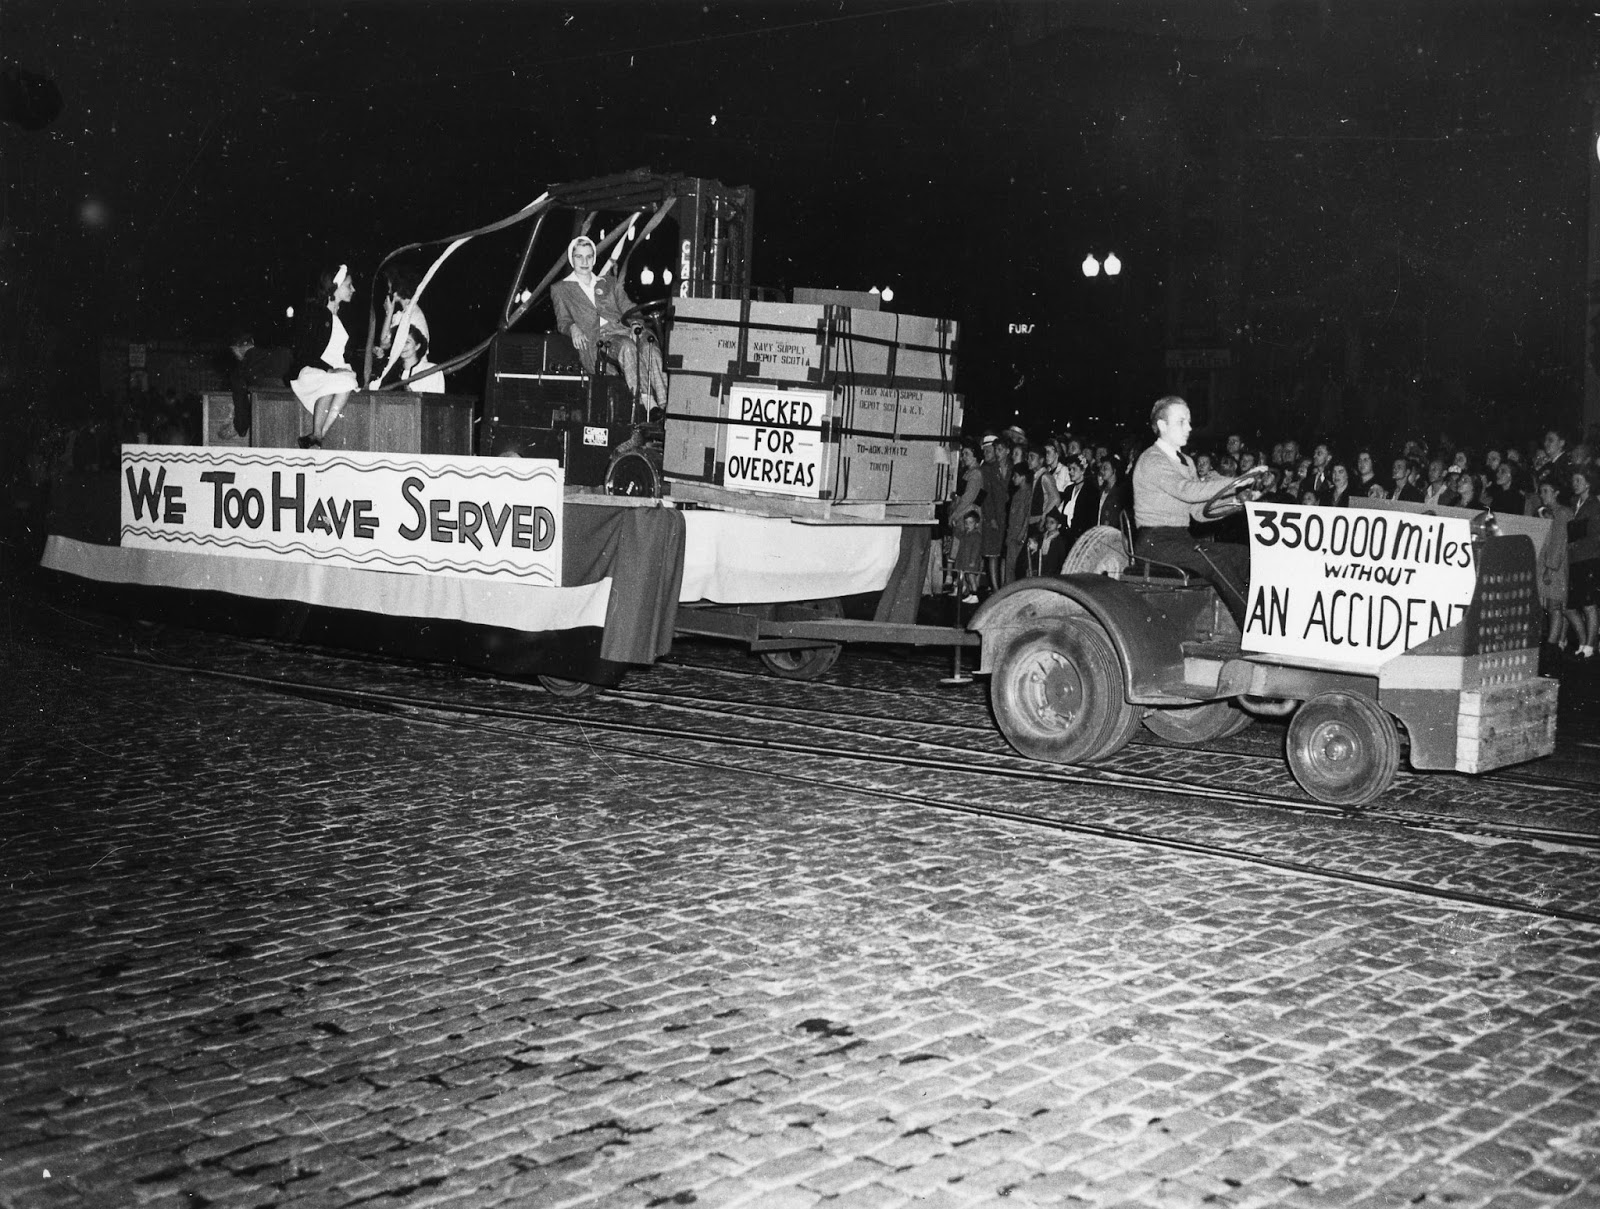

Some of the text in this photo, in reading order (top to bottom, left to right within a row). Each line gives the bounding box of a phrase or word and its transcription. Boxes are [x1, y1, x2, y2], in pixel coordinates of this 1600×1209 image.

[1008, 323, 1036, 334] FURS
[776, 344, 807, 355] SUPPLY
[753, 352, 811, 367] DEPOT SCOTIA
[899, 391, 924, 402] SUPPLY
[741, 397, 812, 426] PACKED
[859, 400, 880, 411] DEPOT
[882, 403, 907, 415] SCOIA
[754, 428, 794, 455] FOR
[728, 455, 815, 488] OVERSEAS
[870, 462, 890, 472] TOKYO
[1253, 509, 1387, 561] 350,000
[1325, 562, 1416, 586] WITHOUT
[1246, 585, 1471, 650] AN ACCIDENT
